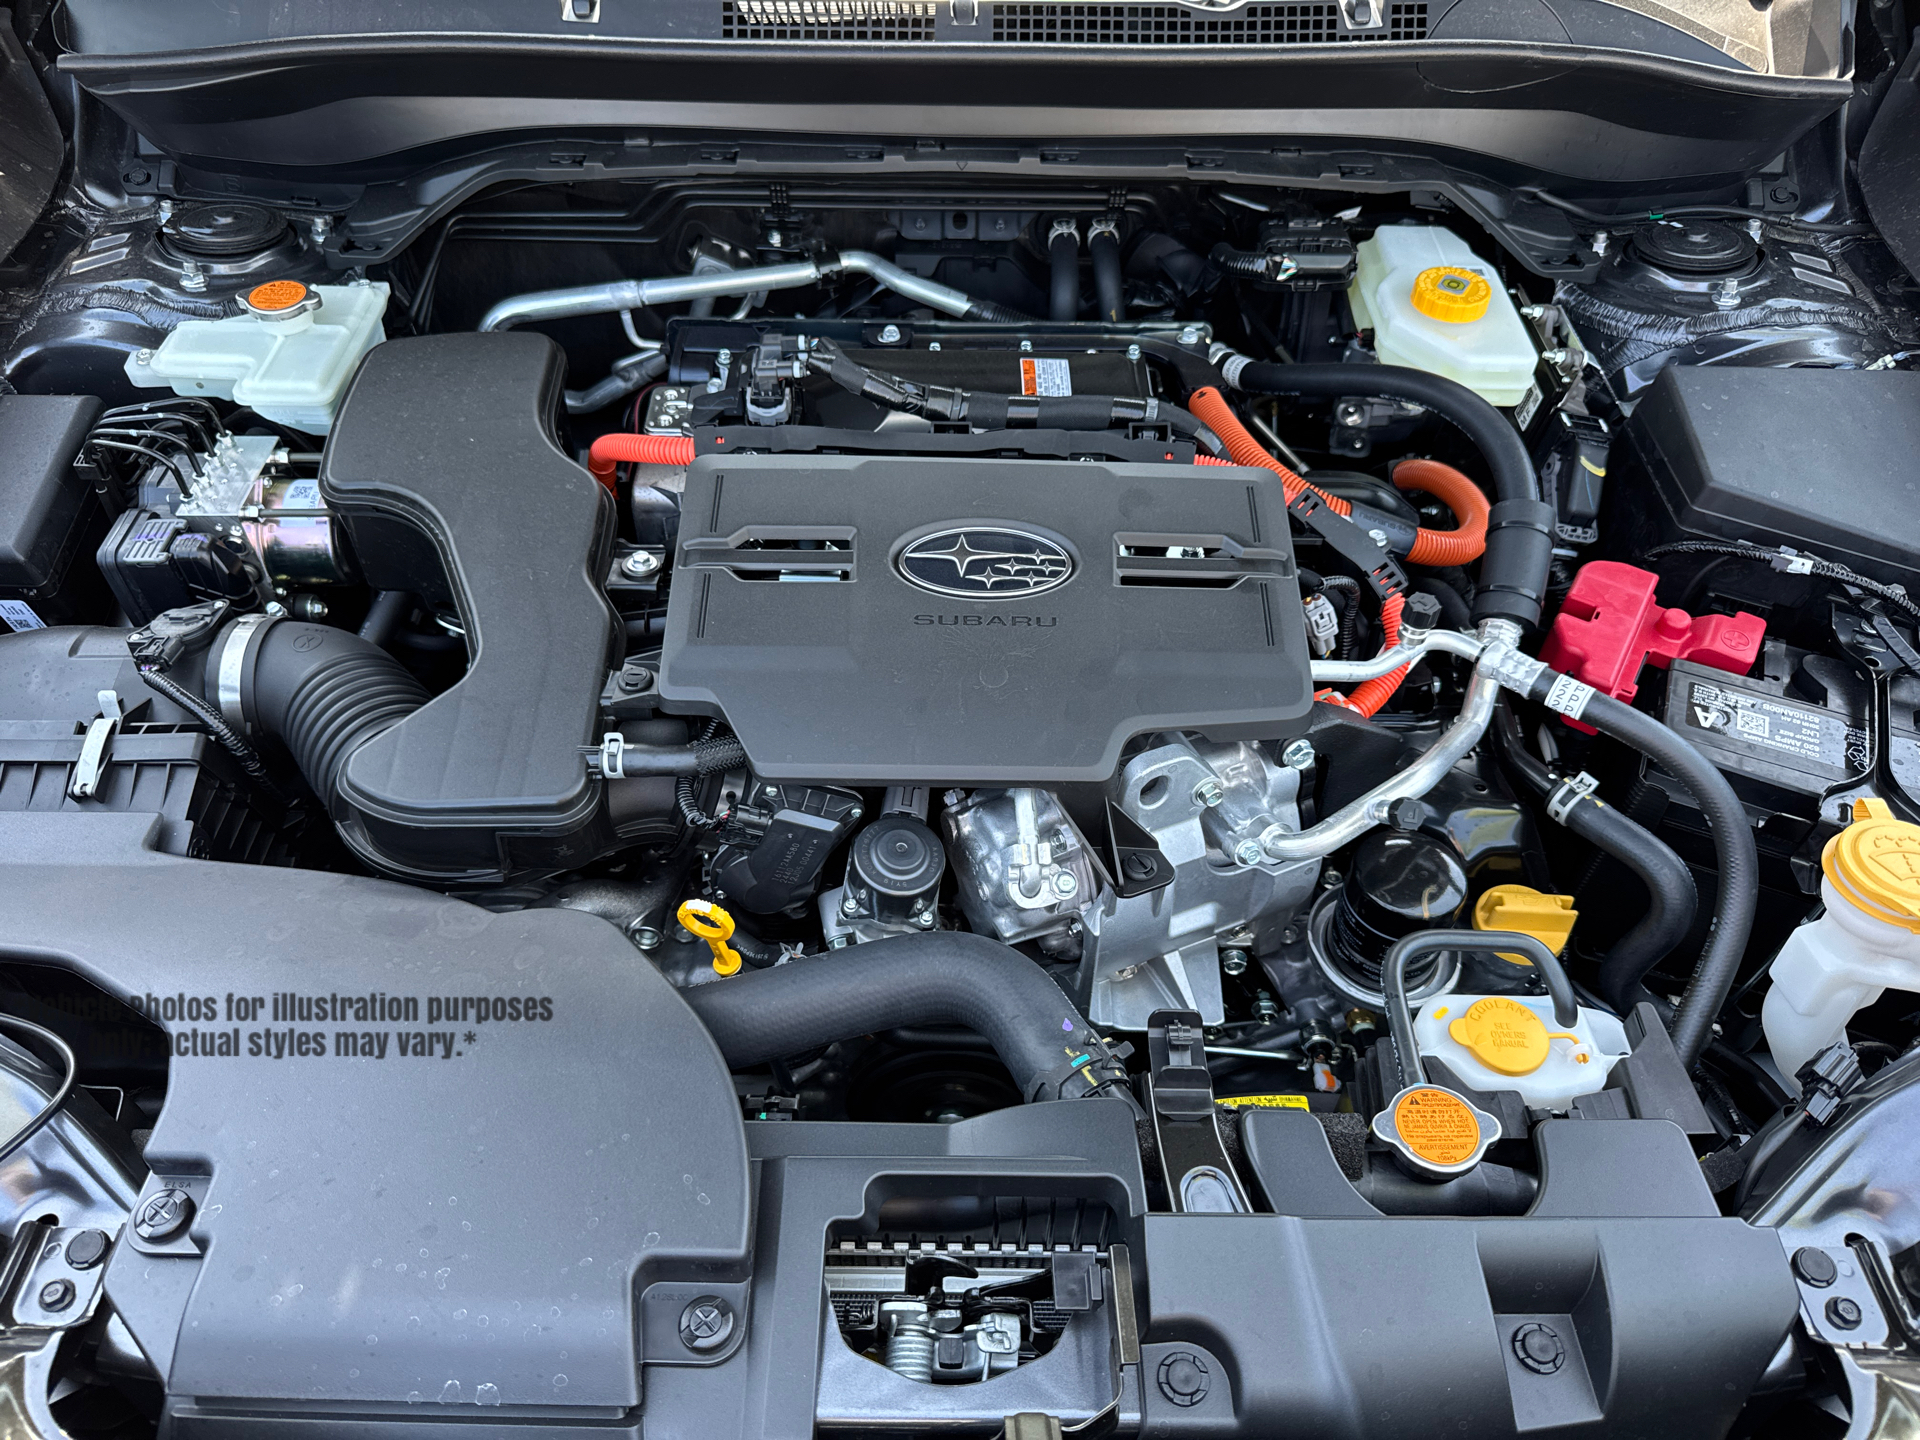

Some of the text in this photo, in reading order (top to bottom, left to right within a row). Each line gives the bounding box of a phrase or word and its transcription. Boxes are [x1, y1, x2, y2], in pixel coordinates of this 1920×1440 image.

[913, 614, 1057, 627] SUBARU
[1774, 734, 1802, 747] AMPS
[1469, 999, 1537, 1022] COOLANT
[164, 1181, 192, 1189] ELSA
